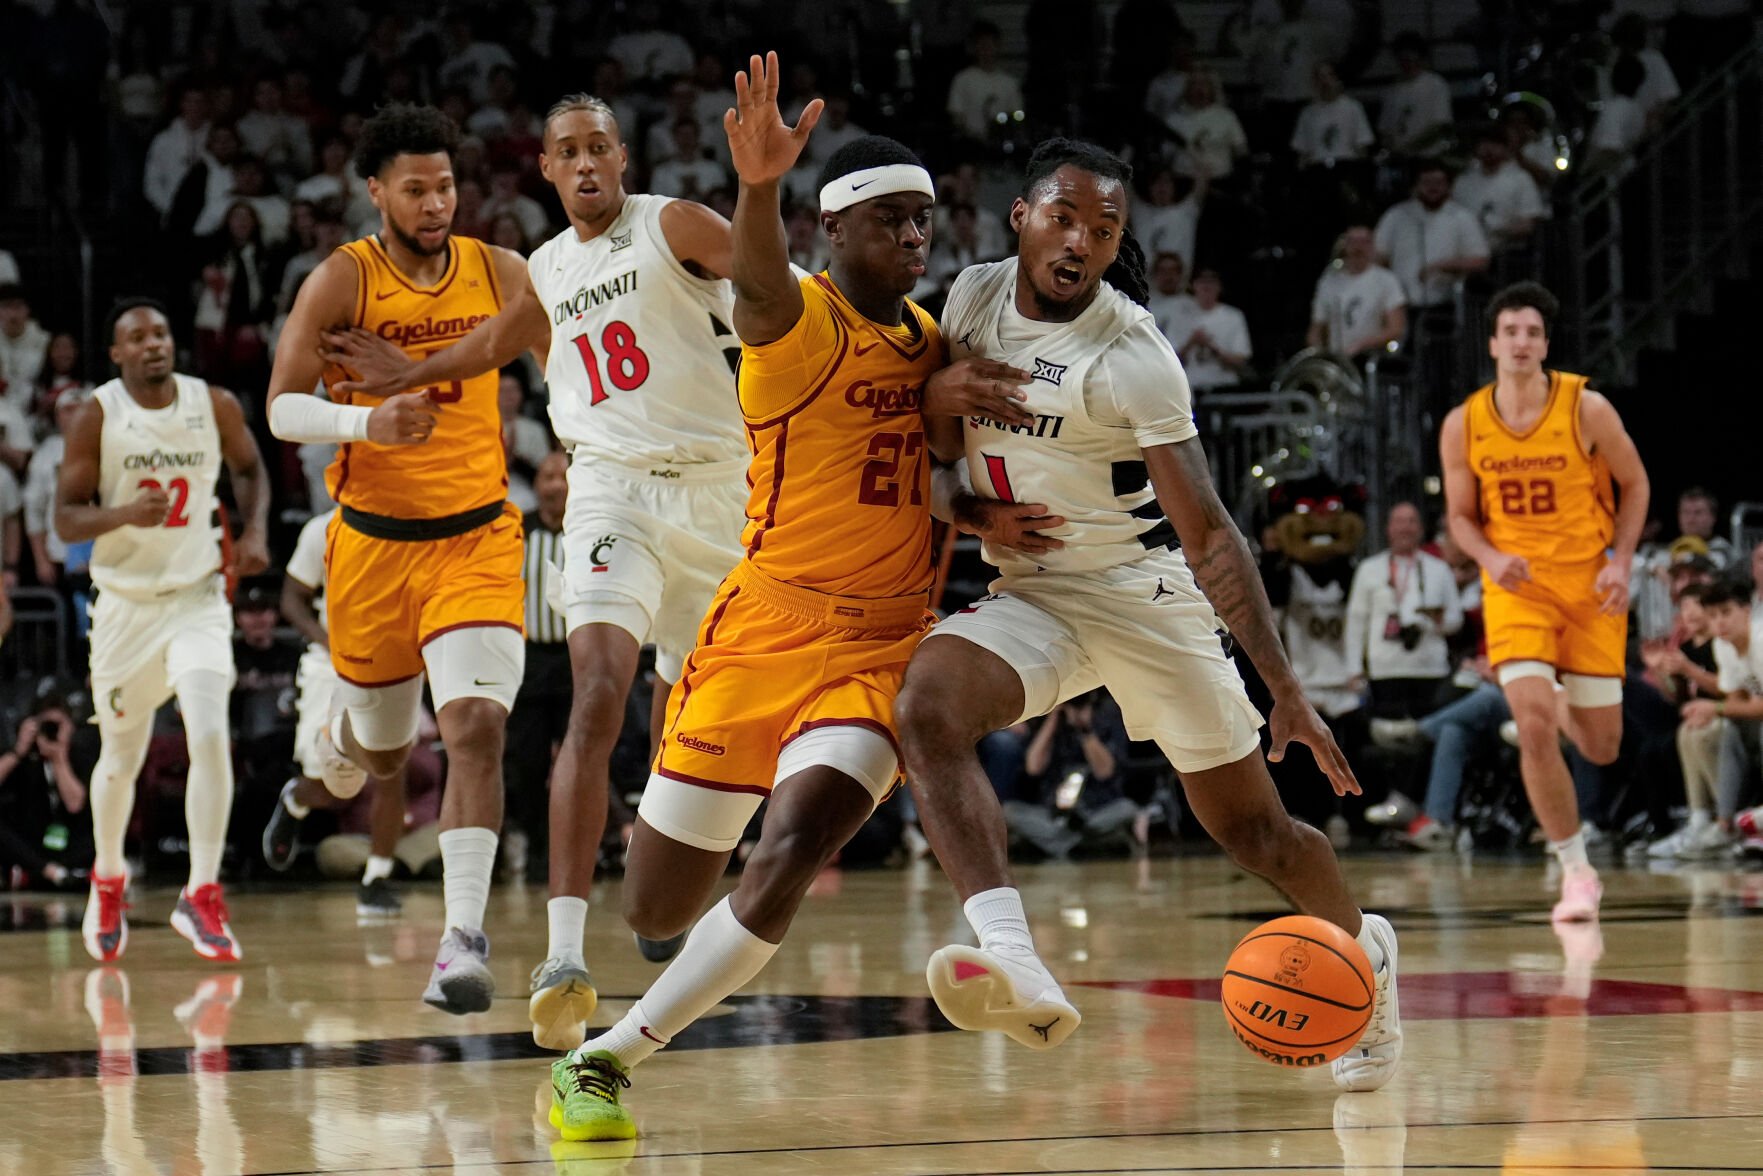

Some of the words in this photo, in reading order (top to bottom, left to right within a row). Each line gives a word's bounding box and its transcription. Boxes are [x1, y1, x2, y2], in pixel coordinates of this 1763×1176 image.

[554, 269, 638, 325] CINCINNATI
[570, 320, 650, 407] 18
[123, 449, 205, 471] CINCINNATI
[857, 430, 924, 508] 27
[980, 451, 1015, 503] 1
[1480, 455, 1567, 473] Cyclones
[1498, 479, 1557, 515] 22
[677, 732, 726, 756] Cyclones
[1248, 1000, 1310, 1032] EVO
